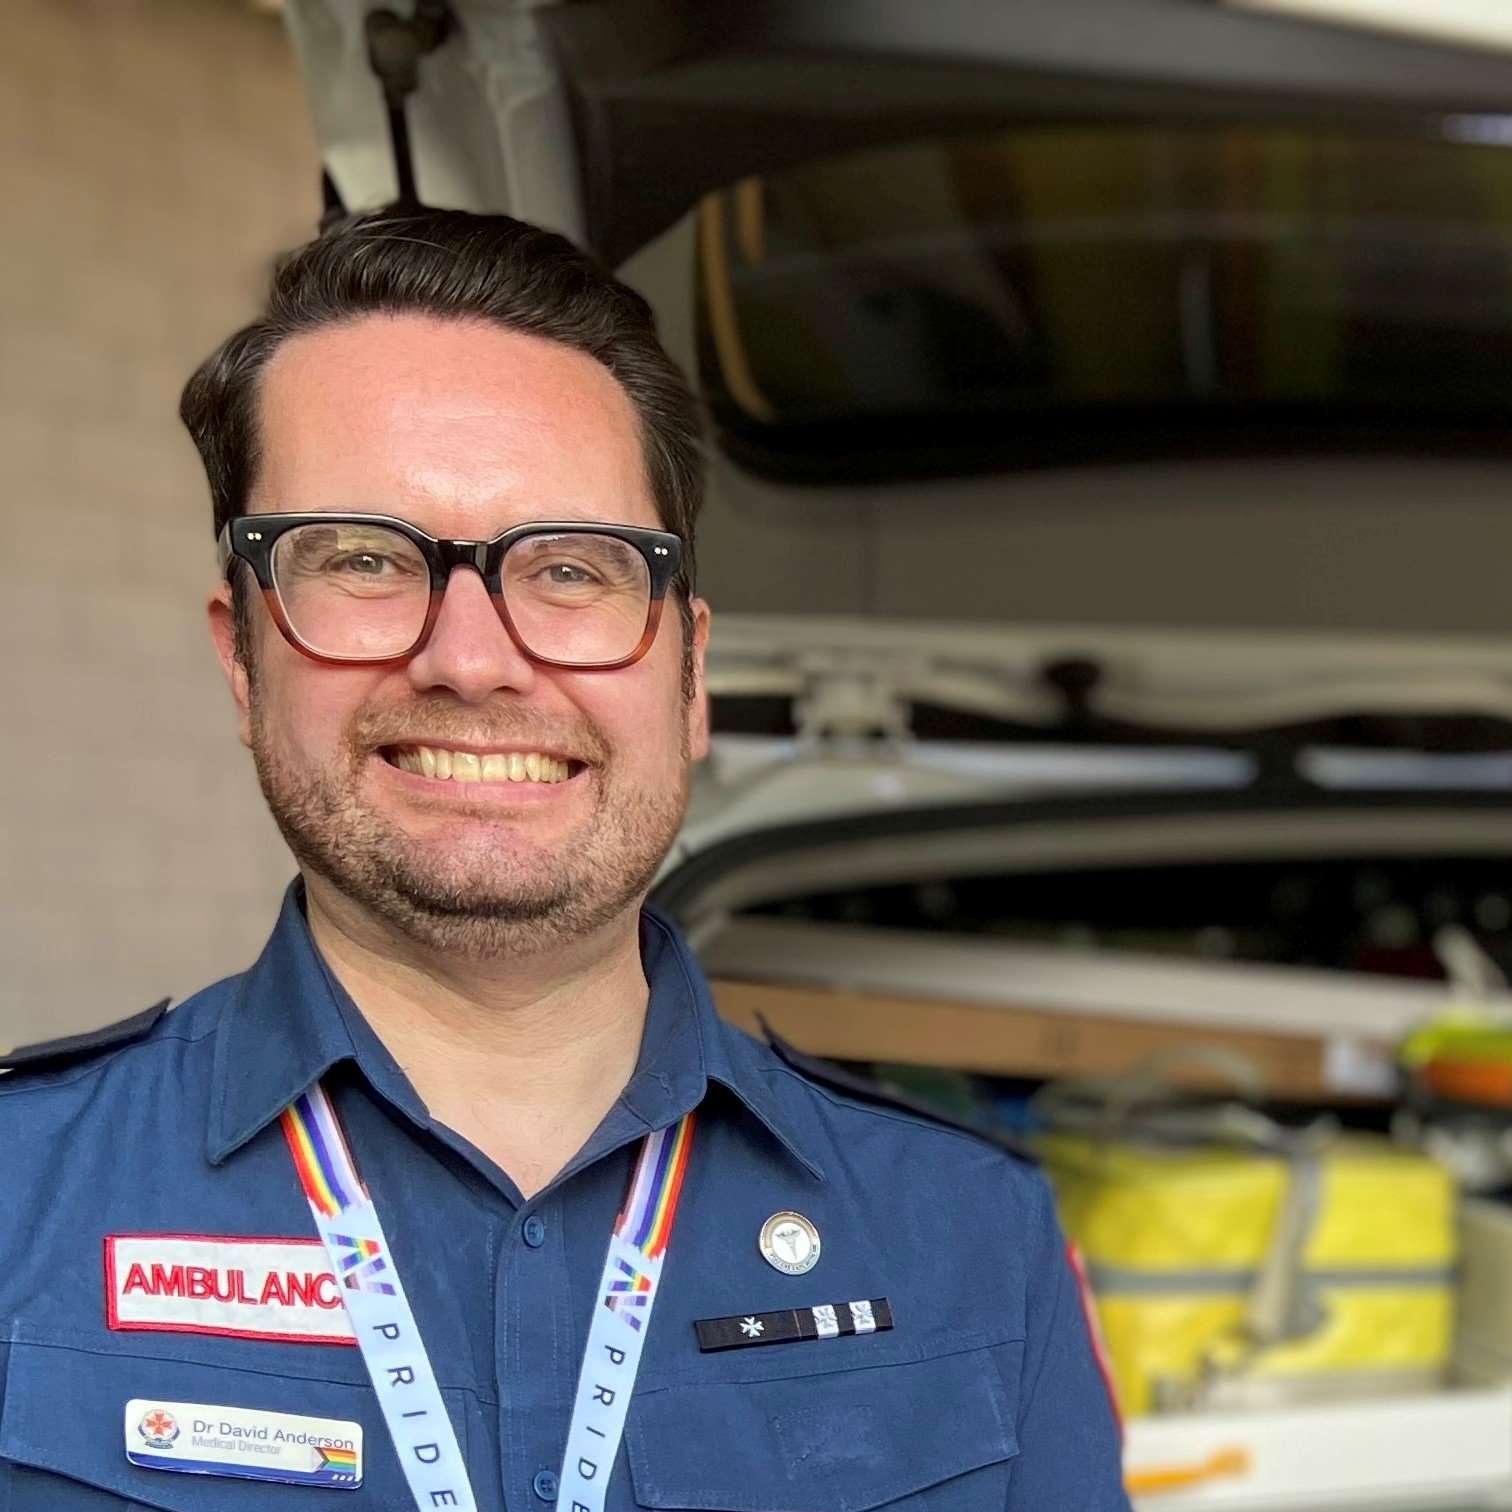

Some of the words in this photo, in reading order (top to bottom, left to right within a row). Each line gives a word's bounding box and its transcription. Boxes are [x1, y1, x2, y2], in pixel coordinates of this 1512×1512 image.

[122, 1262, 346, 1311] AMBULANC
[193, 1419, 213, 1435] Dr
[219, 1421, 268, 1440] David
[273, 1428, 354, 1449] Anderson
[373, 1322, 459, 1508] PRIDE
[191, 1435, 236, 1451] Medical
[238, 1438, 281, 1456] Director
